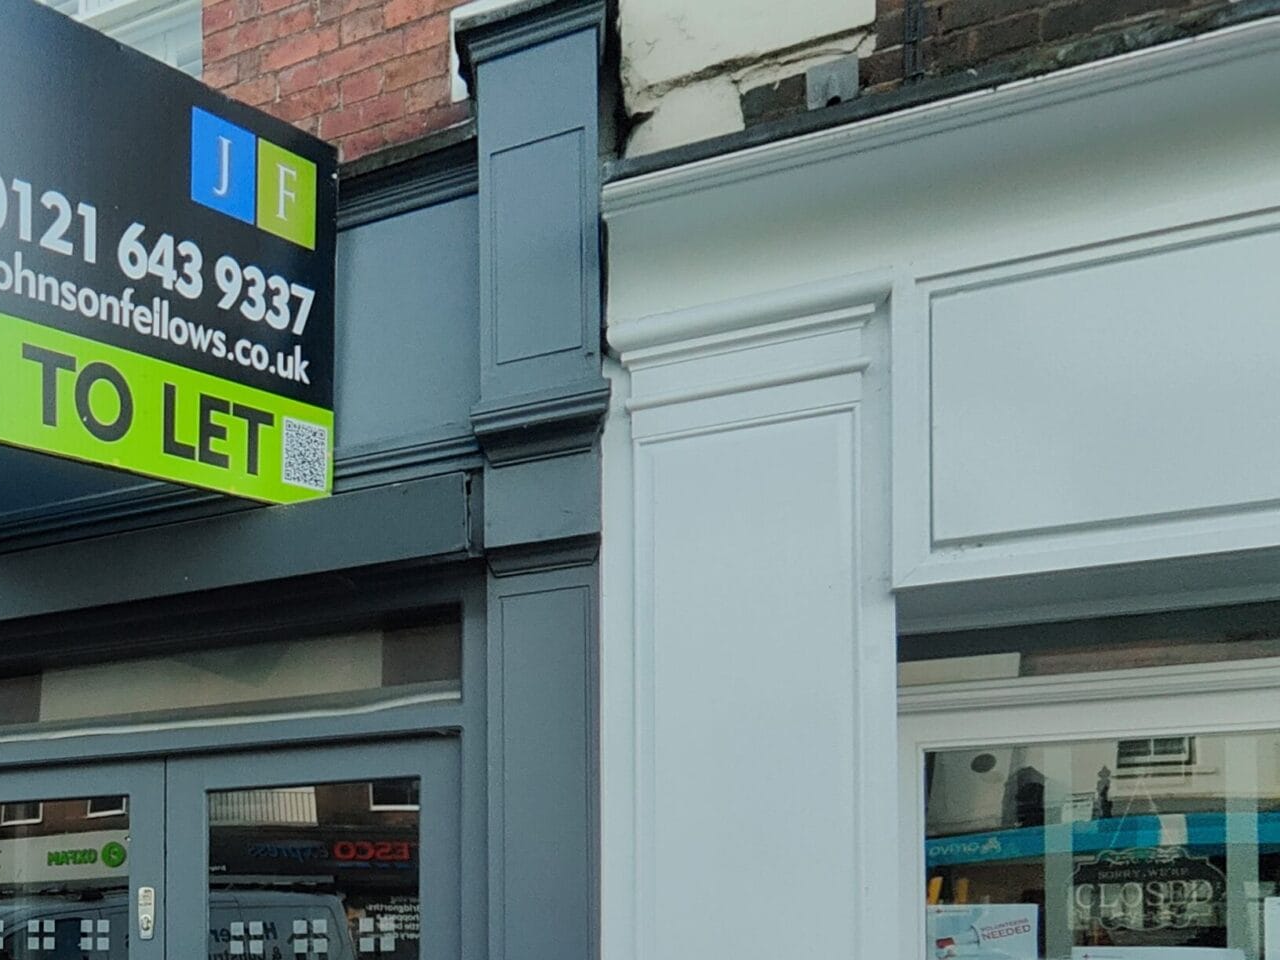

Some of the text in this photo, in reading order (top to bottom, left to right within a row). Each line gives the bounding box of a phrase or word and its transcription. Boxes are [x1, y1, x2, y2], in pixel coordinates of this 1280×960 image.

[213, 136, 297, 221] J F
[117, 222, 203, 299] 643
[215, 256, 315, 336] 9337
[22, 343, 275, 476] TO LET
[982, 924, 1031, 941] NEEDED
[1076, 879, 1213, 908] CLOSED
